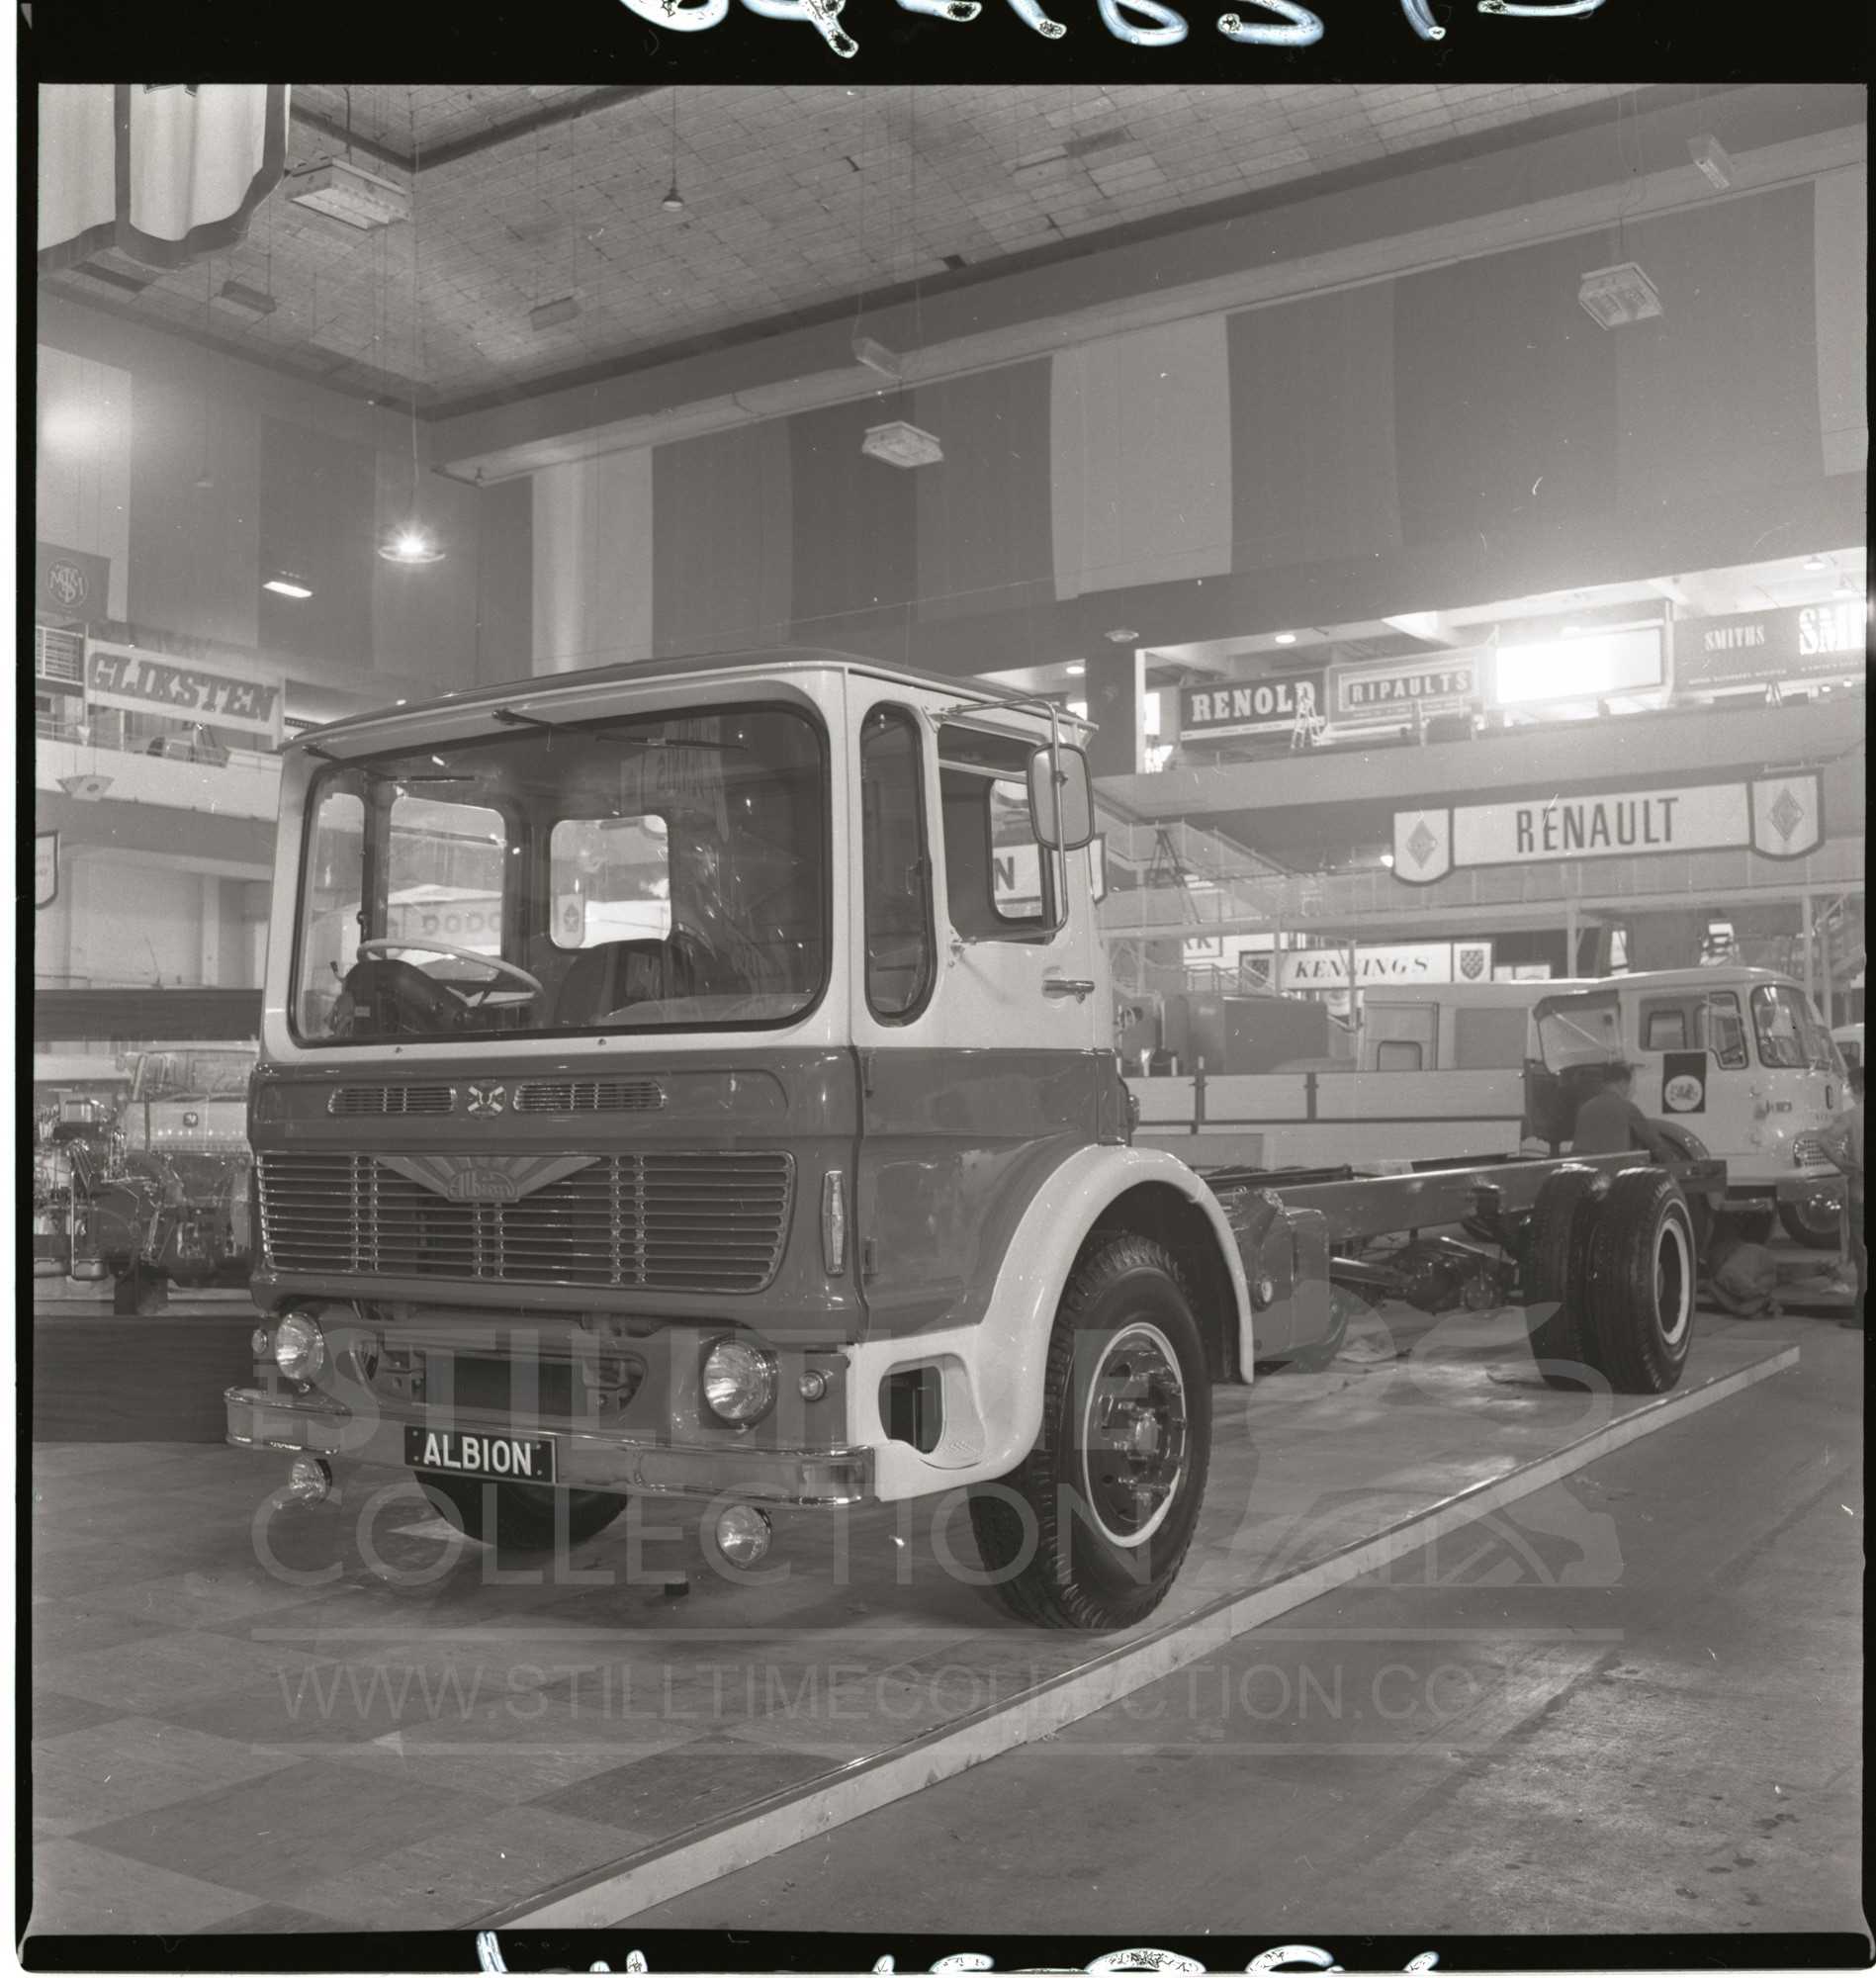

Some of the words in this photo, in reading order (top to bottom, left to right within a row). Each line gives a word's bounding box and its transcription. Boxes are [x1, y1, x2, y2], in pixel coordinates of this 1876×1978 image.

[87, 650, 281, 724] GLIKSTEN
[1191, 680, 1316, 723] RENOLD
[1352, 672, 1469, 703] RIPAULTS
[1516, 795, 1679, 854] RENAULT
[423, 1432, 532, 1477] ALBION
